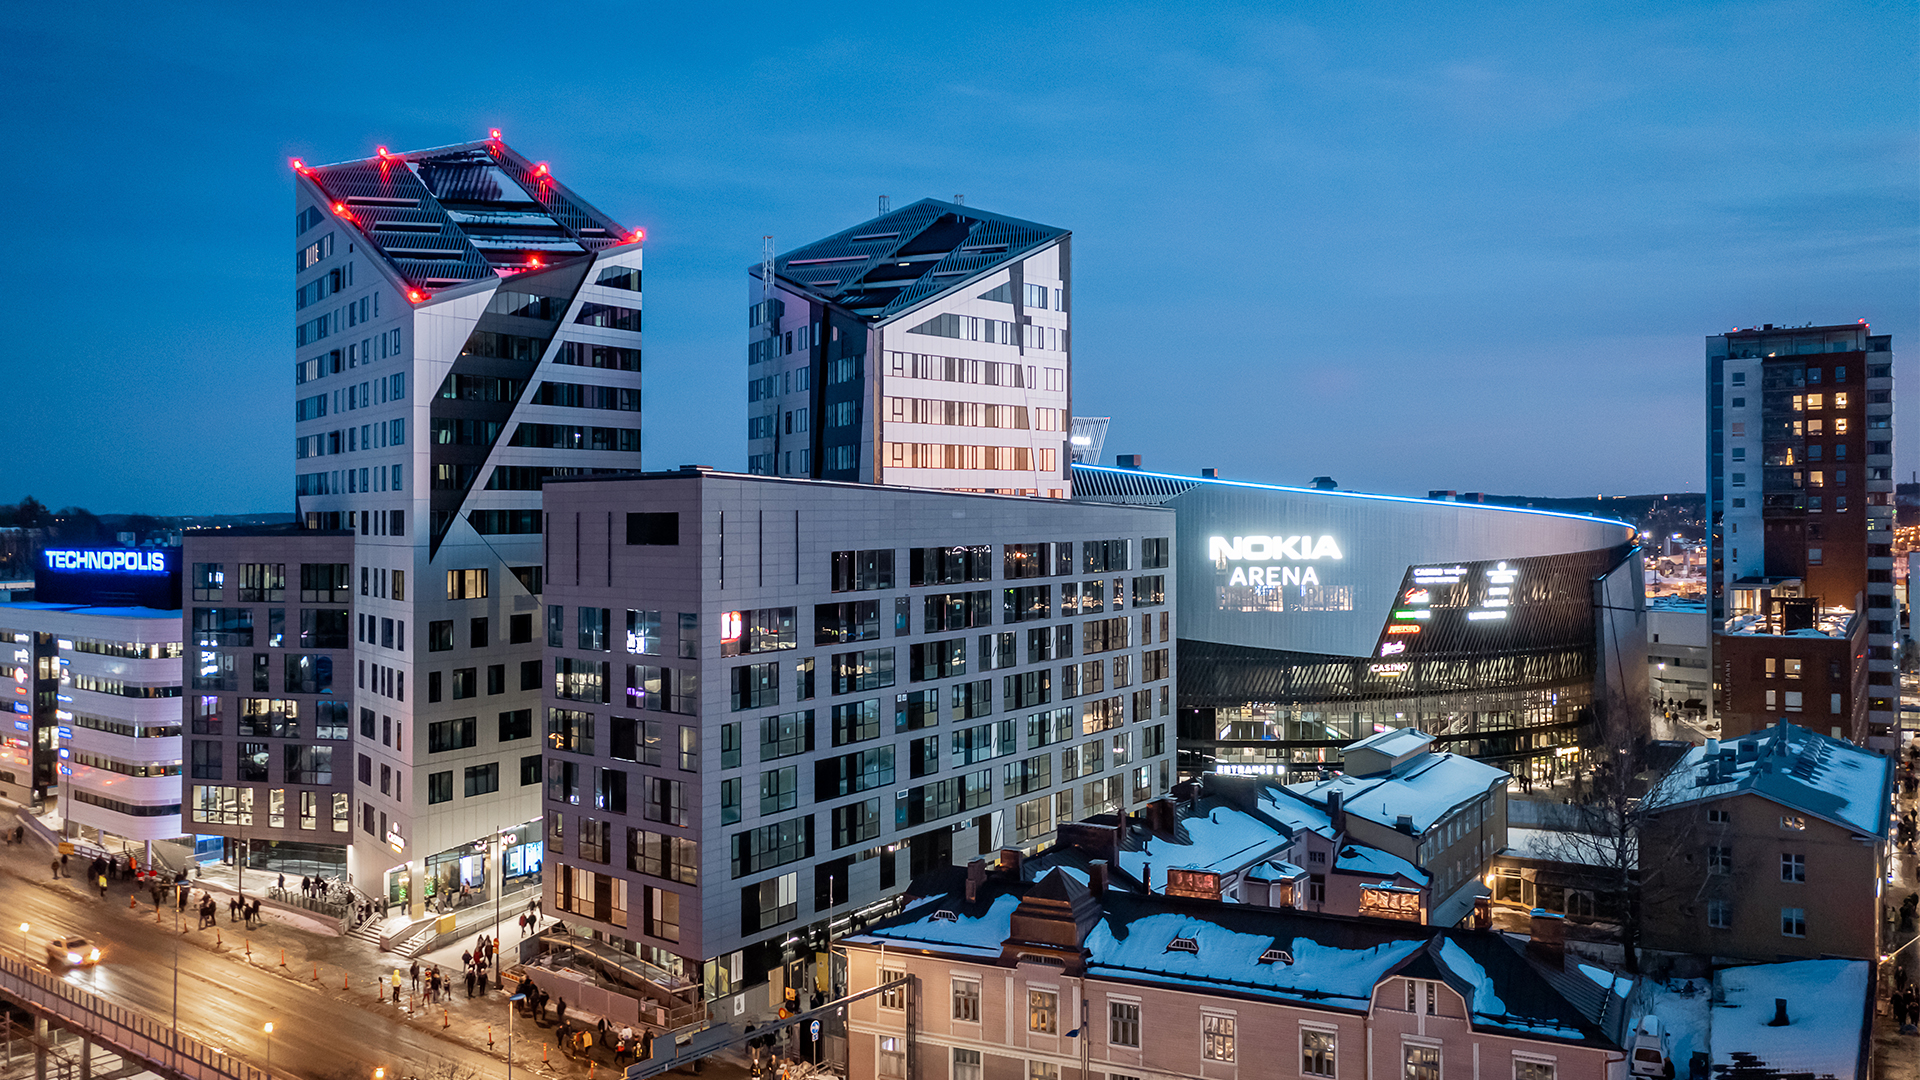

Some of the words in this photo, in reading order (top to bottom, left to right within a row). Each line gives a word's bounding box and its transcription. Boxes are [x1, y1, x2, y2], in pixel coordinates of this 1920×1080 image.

[1209, 535, 1343, 560] NOKIA
[45, 550, 164, 571] TECHNOPOLIS
[1229, 566, 1319, 586] ARENA
[1371, 663, 1408, 672] CASINO
[1216, 764, 1274, 775] ENTRANCE
